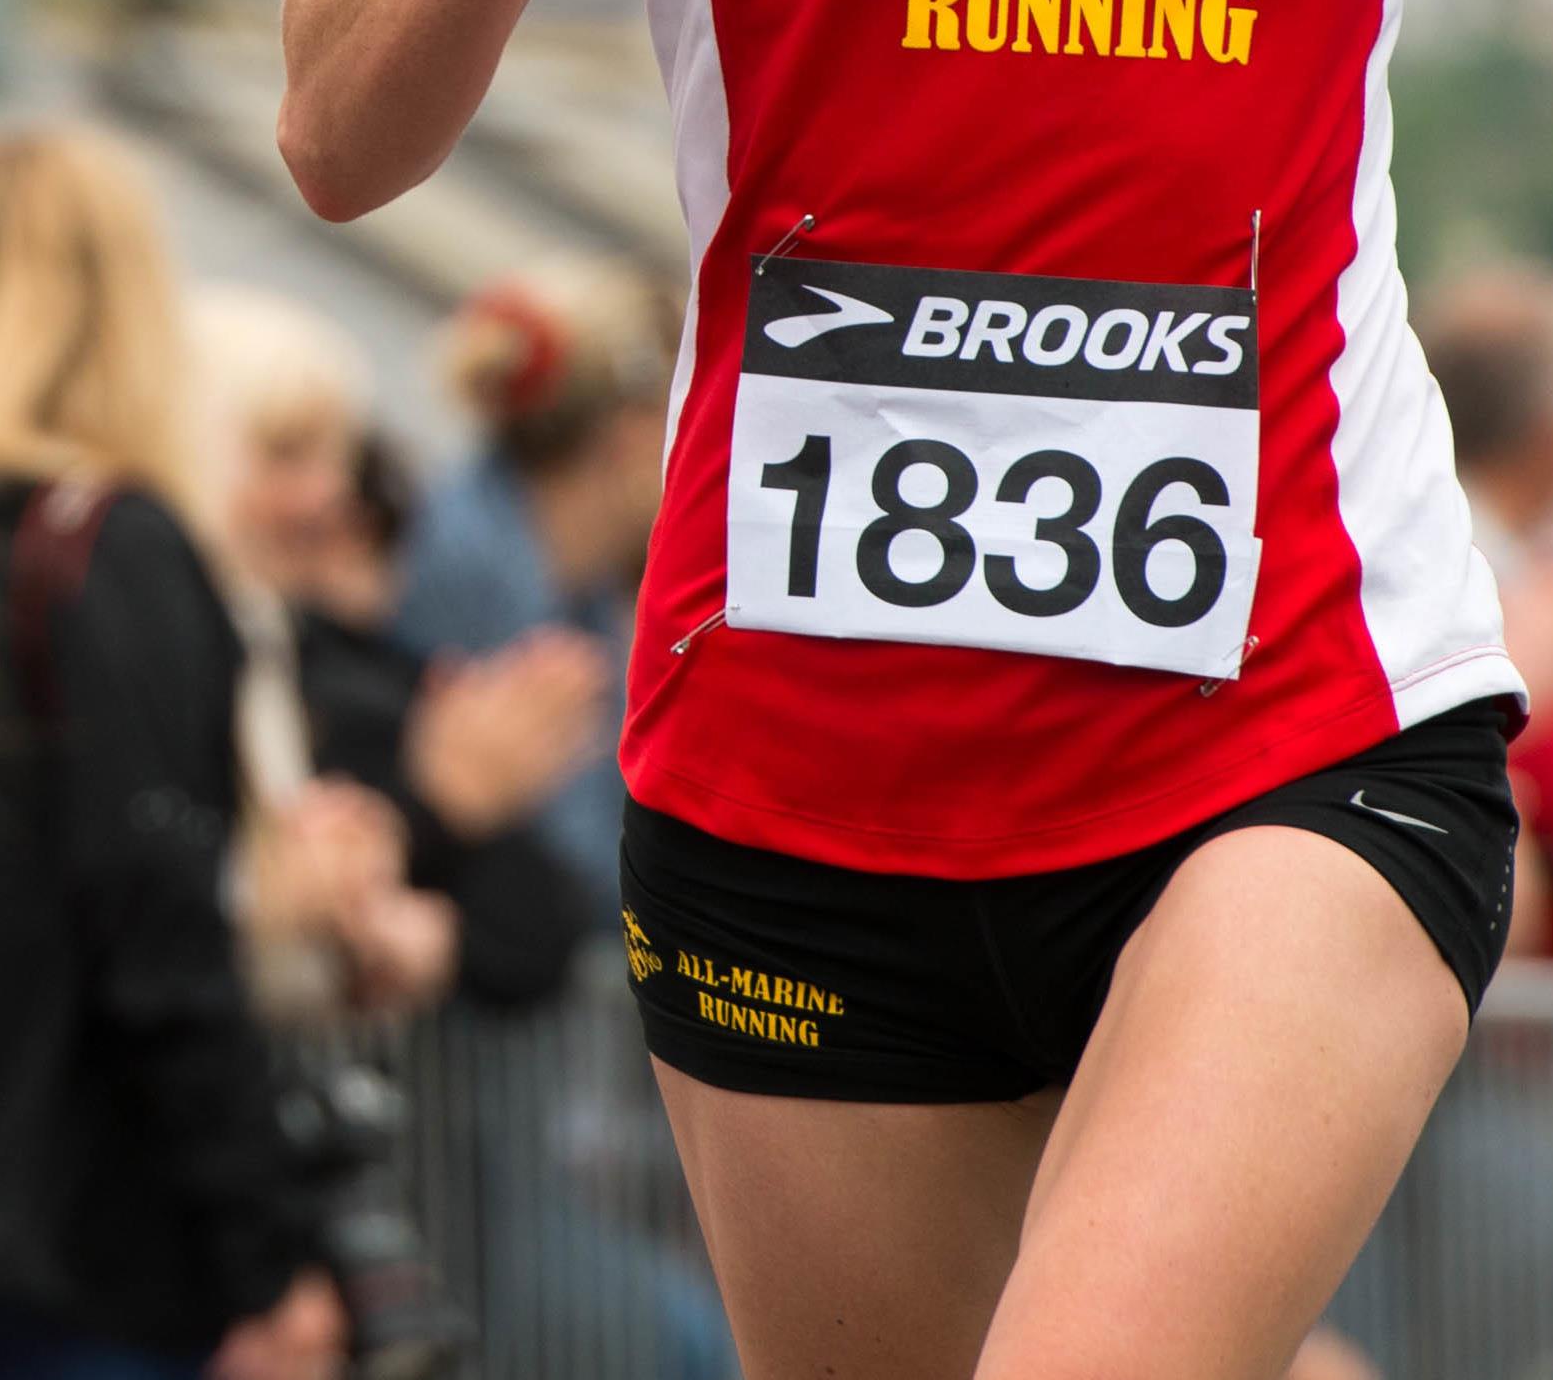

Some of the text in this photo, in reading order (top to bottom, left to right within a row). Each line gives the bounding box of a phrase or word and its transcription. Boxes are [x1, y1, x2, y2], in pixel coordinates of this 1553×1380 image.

[901, 296, 1250, 378] BROOKS
[760, 433, 1229, 627] 1836
[677, 950, 844, 1016] ALL-MARINE
[698, 991, 820, 1047] RUNNING
